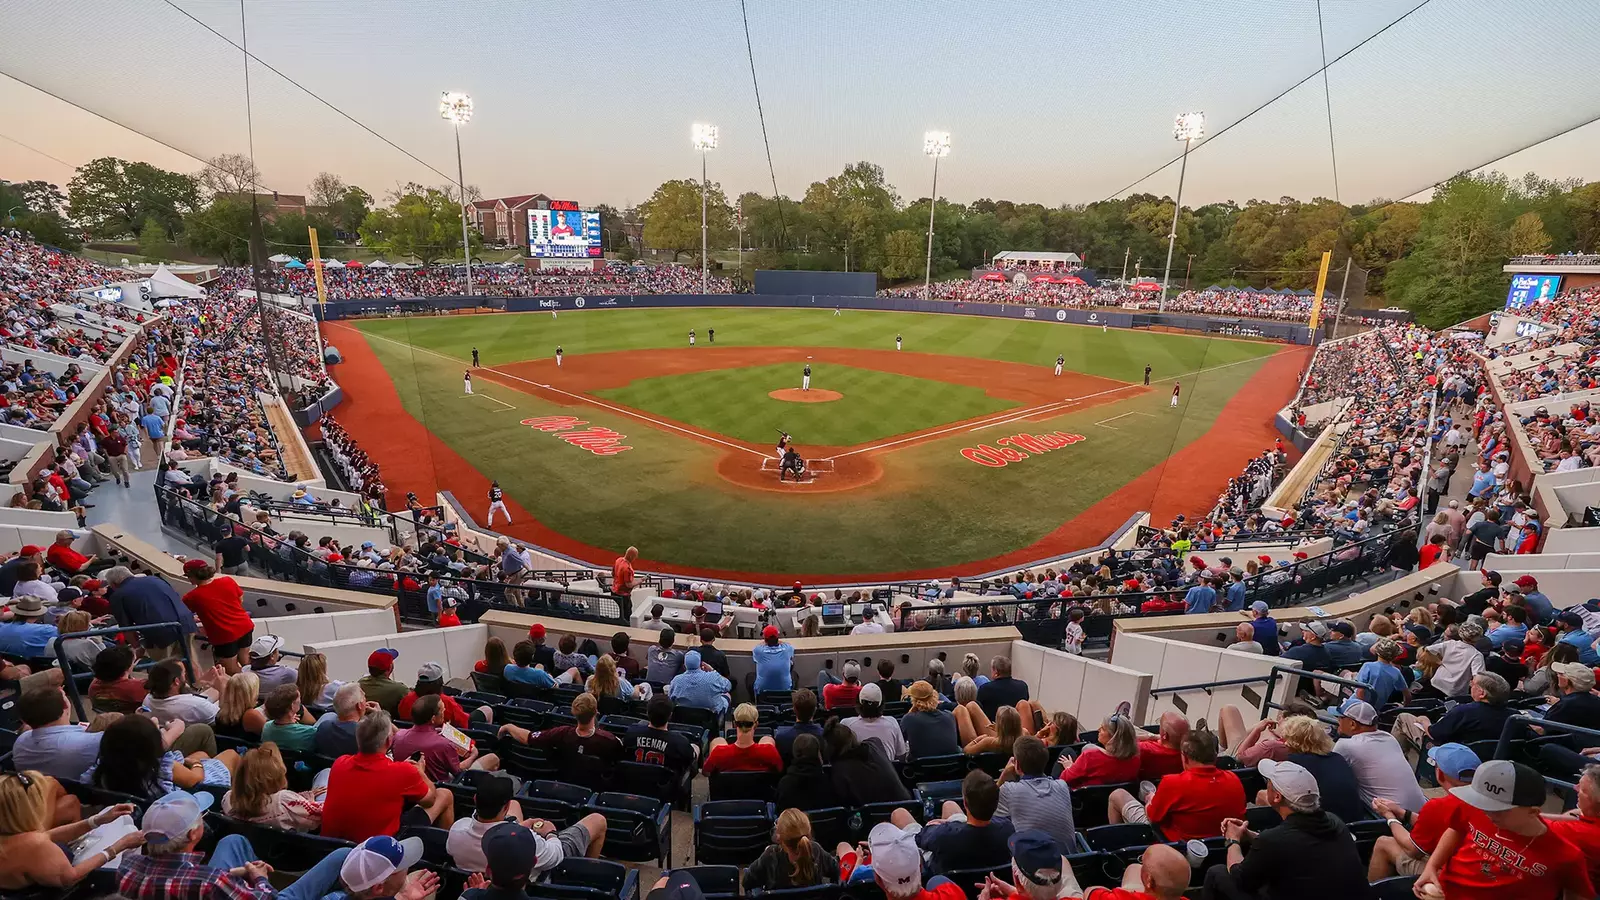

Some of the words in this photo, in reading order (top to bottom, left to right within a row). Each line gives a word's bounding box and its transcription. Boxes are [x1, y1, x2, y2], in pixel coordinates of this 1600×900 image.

[520, 415, 589, 432] Ole
[552, 426, 634, 456] Miss
[960, 443, 1029, 467] Ole
[996, 430, 1087, 454] Miss
[636, 736, 668, 752] KEENAN
[897, 876, 911, 885] M
